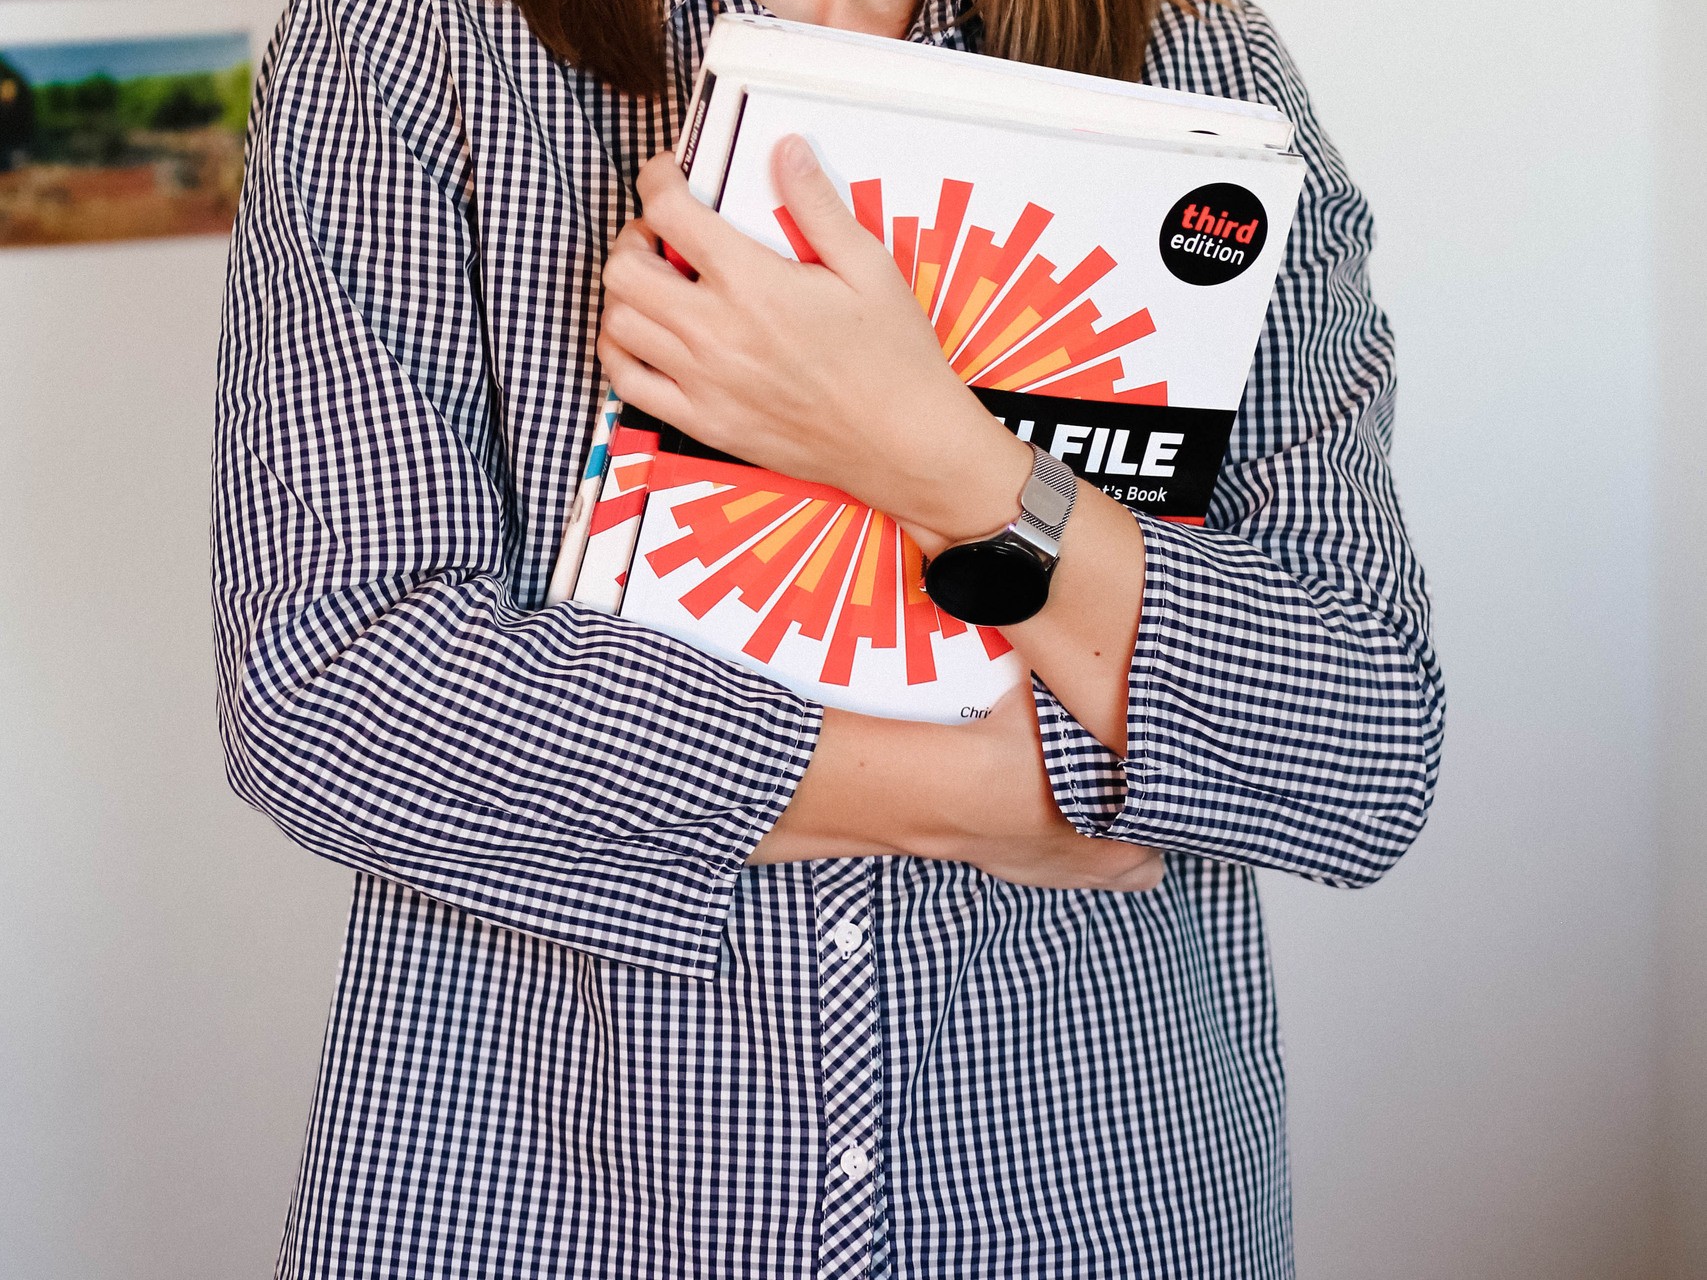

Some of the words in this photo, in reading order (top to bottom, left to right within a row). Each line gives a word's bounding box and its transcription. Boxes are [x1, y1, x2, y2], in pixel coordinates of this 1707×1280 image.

[689, 99, 706, 150] ENGLISH
[1181, 203, 1259, 245] third
[1170, 233, 1245, 266] edition
[1050, 423, 1185, 478] FILE
[1126, 486, 1168, 503] Book
